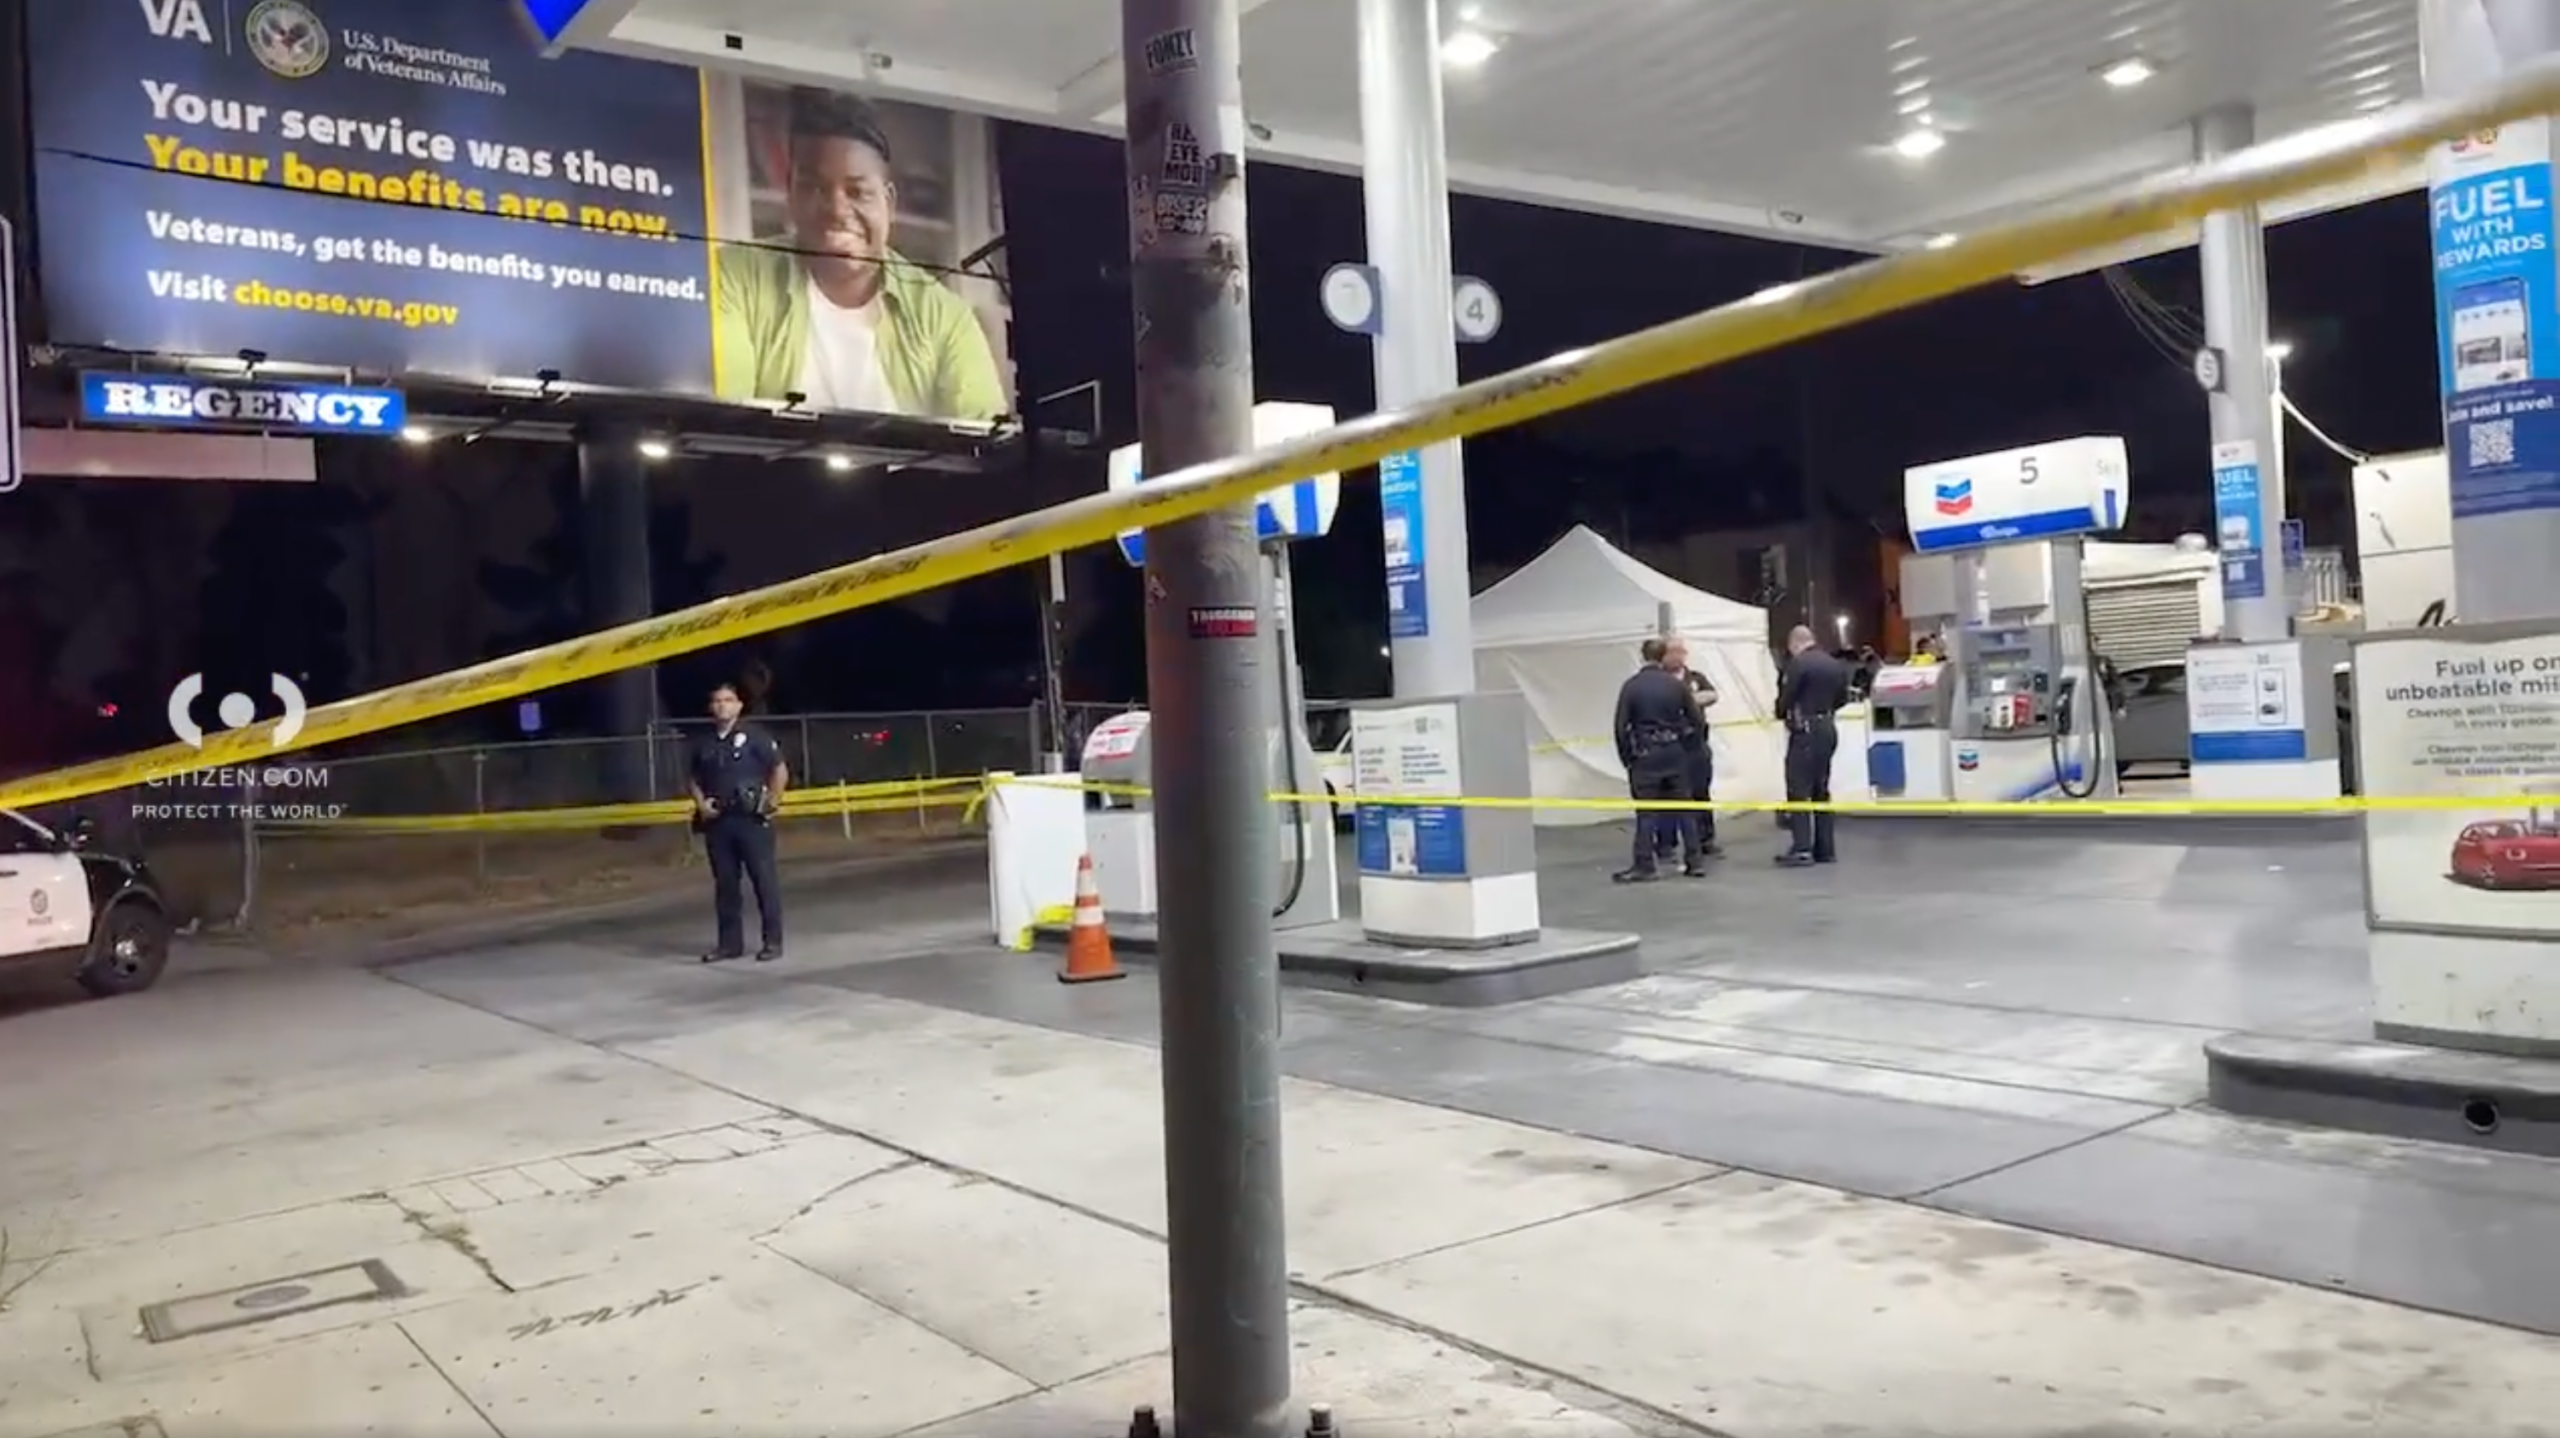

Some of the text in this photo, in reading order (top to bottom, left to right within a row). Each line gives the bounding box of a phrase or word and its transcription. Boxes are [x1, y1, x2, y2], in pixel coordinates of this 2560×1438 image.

[138, 0, 212, 43] VA
[343, 29, 492, 73] U.S. Department
[344, 53, 507, 96] of Veterans Affairs
[141, 79, 674, 197] Your service was then.
[144, 134, 679, 242] Your benefits are now.
[2435, 177, 2545, 229] FUEL
[2451, 215, 2514, 244] WITH
[146, 210, 705, 301] Veterans, get the benefits you earned.
[147, 270, 459, 327] Visit choose.va.gov
[1466, 297, 1485, 323] 4
[103, 381, 390, 426] REGENCY
[2019, 456, 2039, 485] 5
[2435, 657, 2486, 678] Fuel
[2494, 659, 2525, 675] up
[2386, 678, 2513, 702] unbeatable
